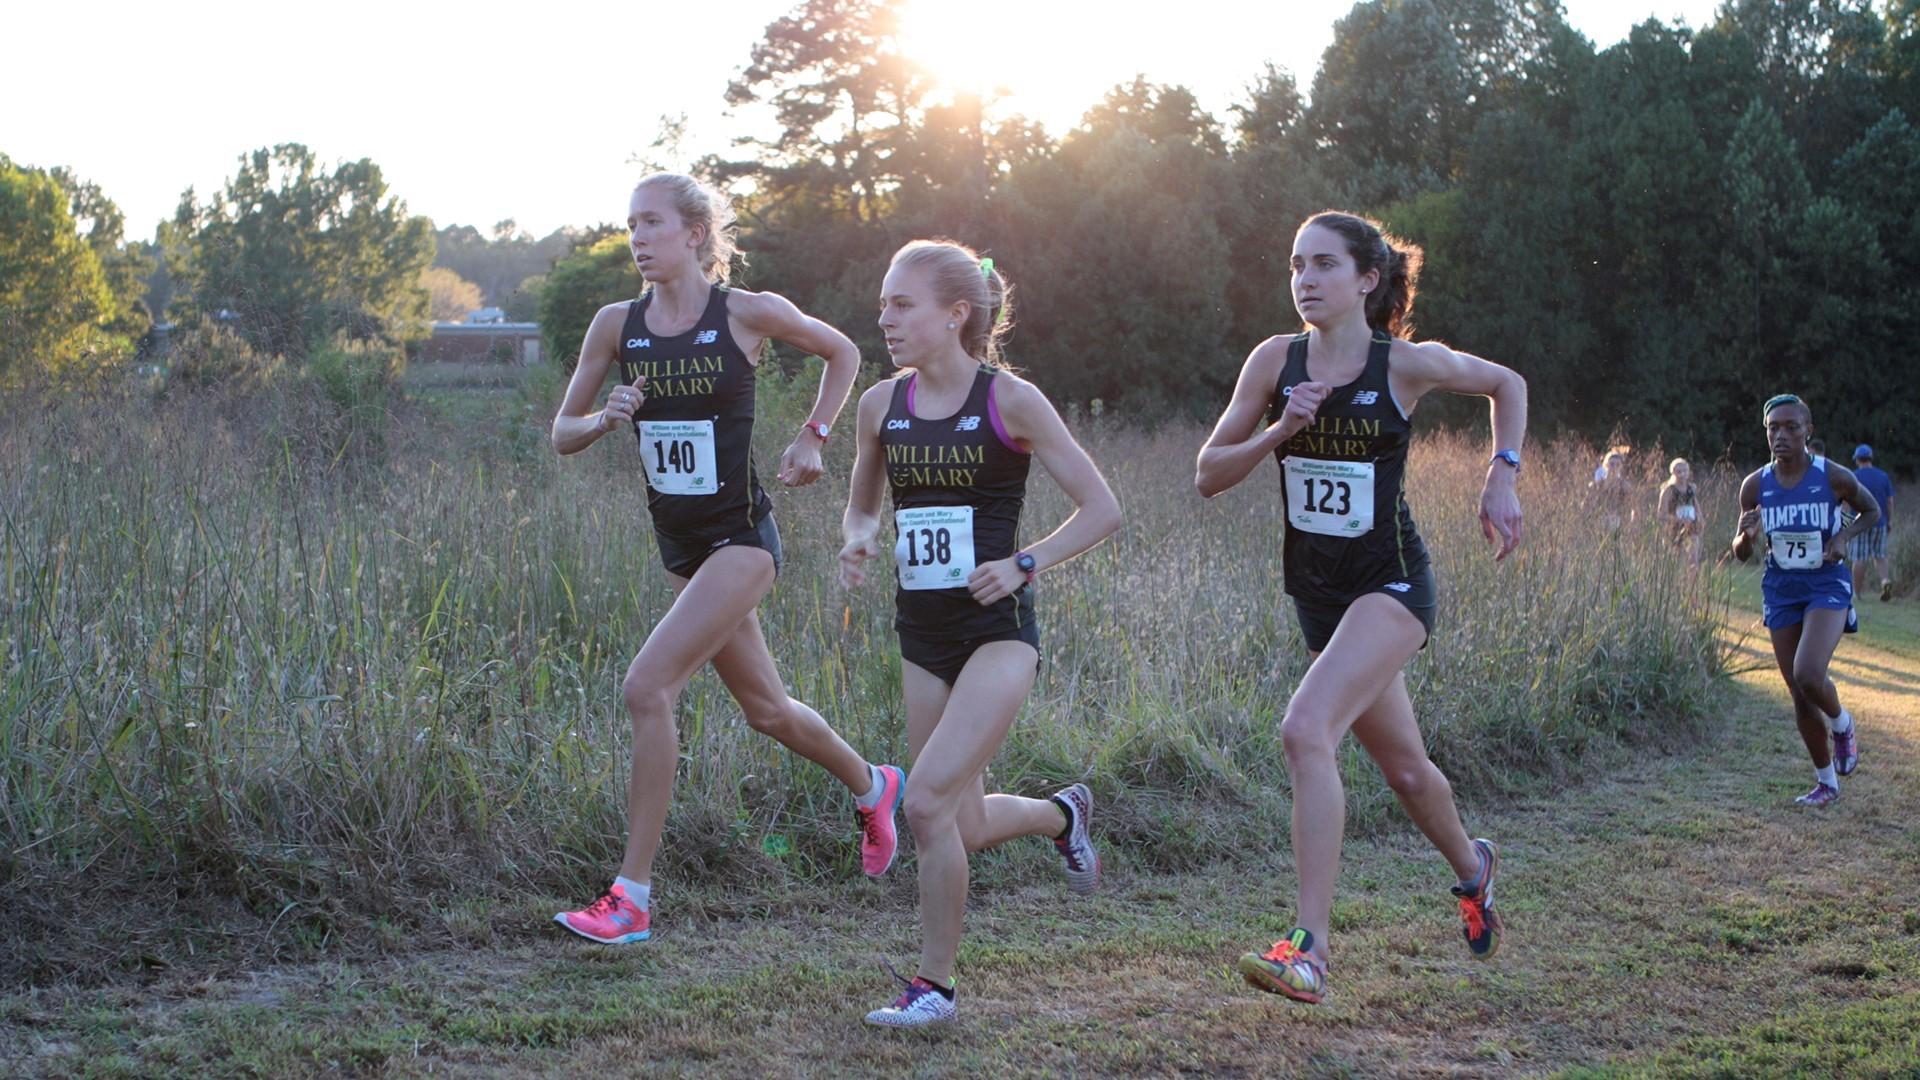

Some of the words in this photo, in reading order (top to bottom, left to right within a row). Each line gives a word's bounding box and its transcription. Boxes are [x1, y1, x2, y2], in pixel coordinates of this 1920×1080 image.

[626, 338, 650, 349] CAA
[626, 356, 725, 381] WILLIAM
[886, 419, 911, 430] CAA
[1305, 416, 1381, 437] LLIAM
[654, 440, 695, 474] 140
[886, 444, 985, 464] WILLIAM
[1304, 478, 1351, 515] 123
[1760, 502, 1830, 534] HAMPTON
[906, 527, 951, 567] 138
[1786, 541, 1807, 559] 75
